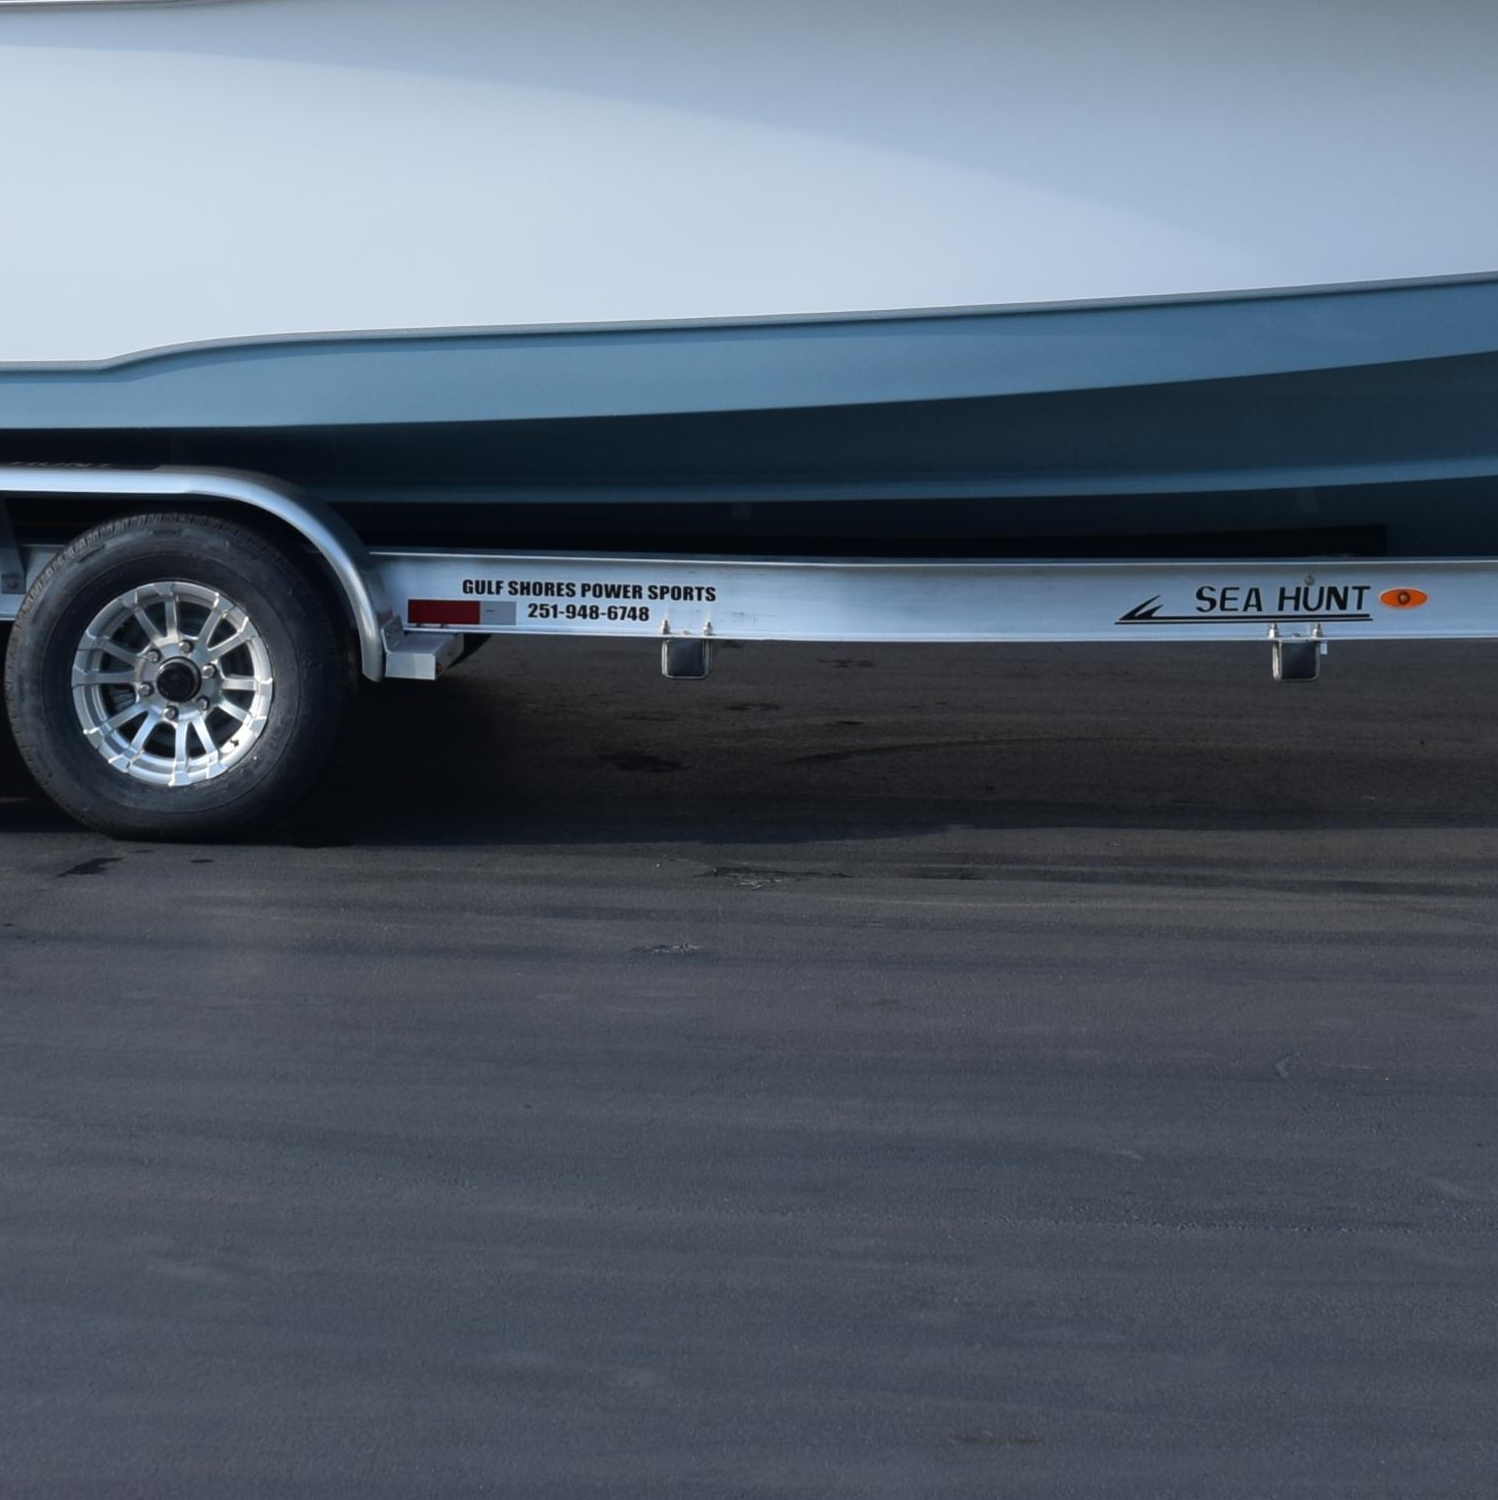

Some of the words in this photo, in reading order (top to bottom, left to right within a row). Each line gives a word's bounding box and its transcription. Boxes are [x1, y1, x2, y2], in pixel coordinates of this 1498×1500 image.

[462, 579, 504, 596] GULF
[508, 580, 577, 599] SHORES
[581, 582, 643, 600] POWER
[647, 584, 717, 602] SPORTS
[1195, 586, 1263, 612] SEA
[1277, 585, 1371, 612] HUNT
[527, 603, 650, 622] 251-948-6748
